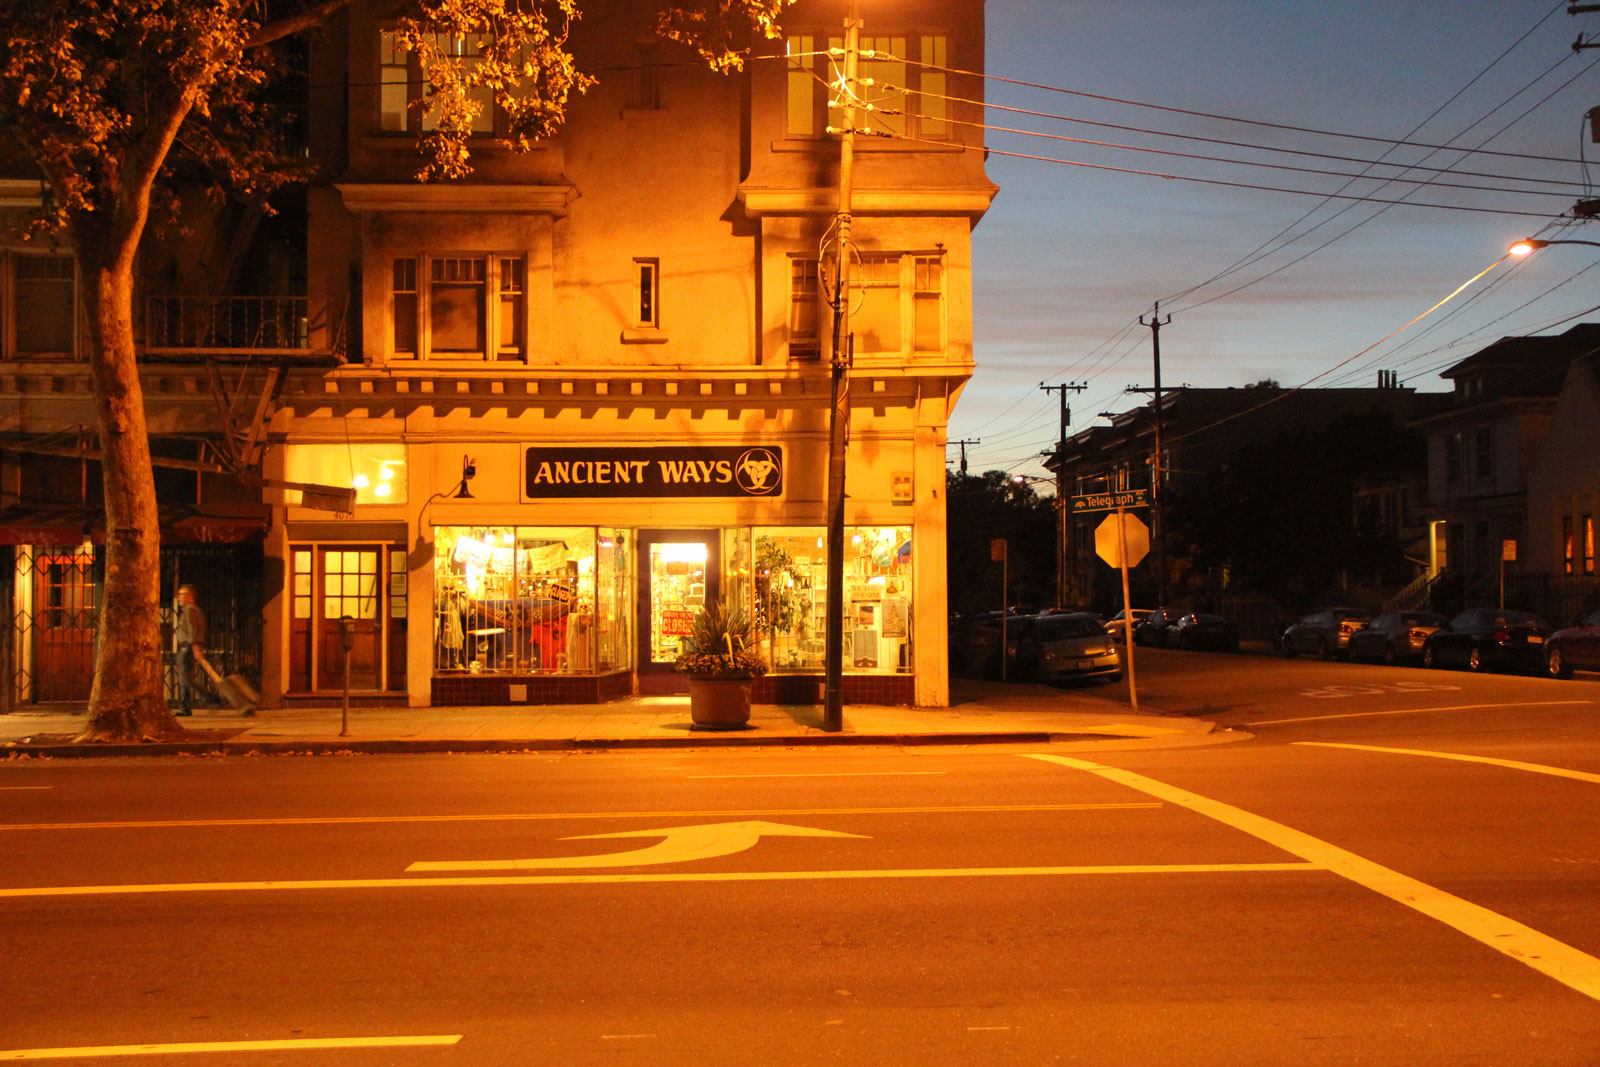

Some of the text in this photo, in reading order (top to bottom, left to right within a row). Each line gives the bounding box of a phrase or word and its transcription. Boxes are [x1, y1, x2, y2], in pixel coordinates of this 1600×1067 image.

[533, 460, 733, 484] ANCIENT WAYS
[1086, 494, 1134, 508] Telegraph
